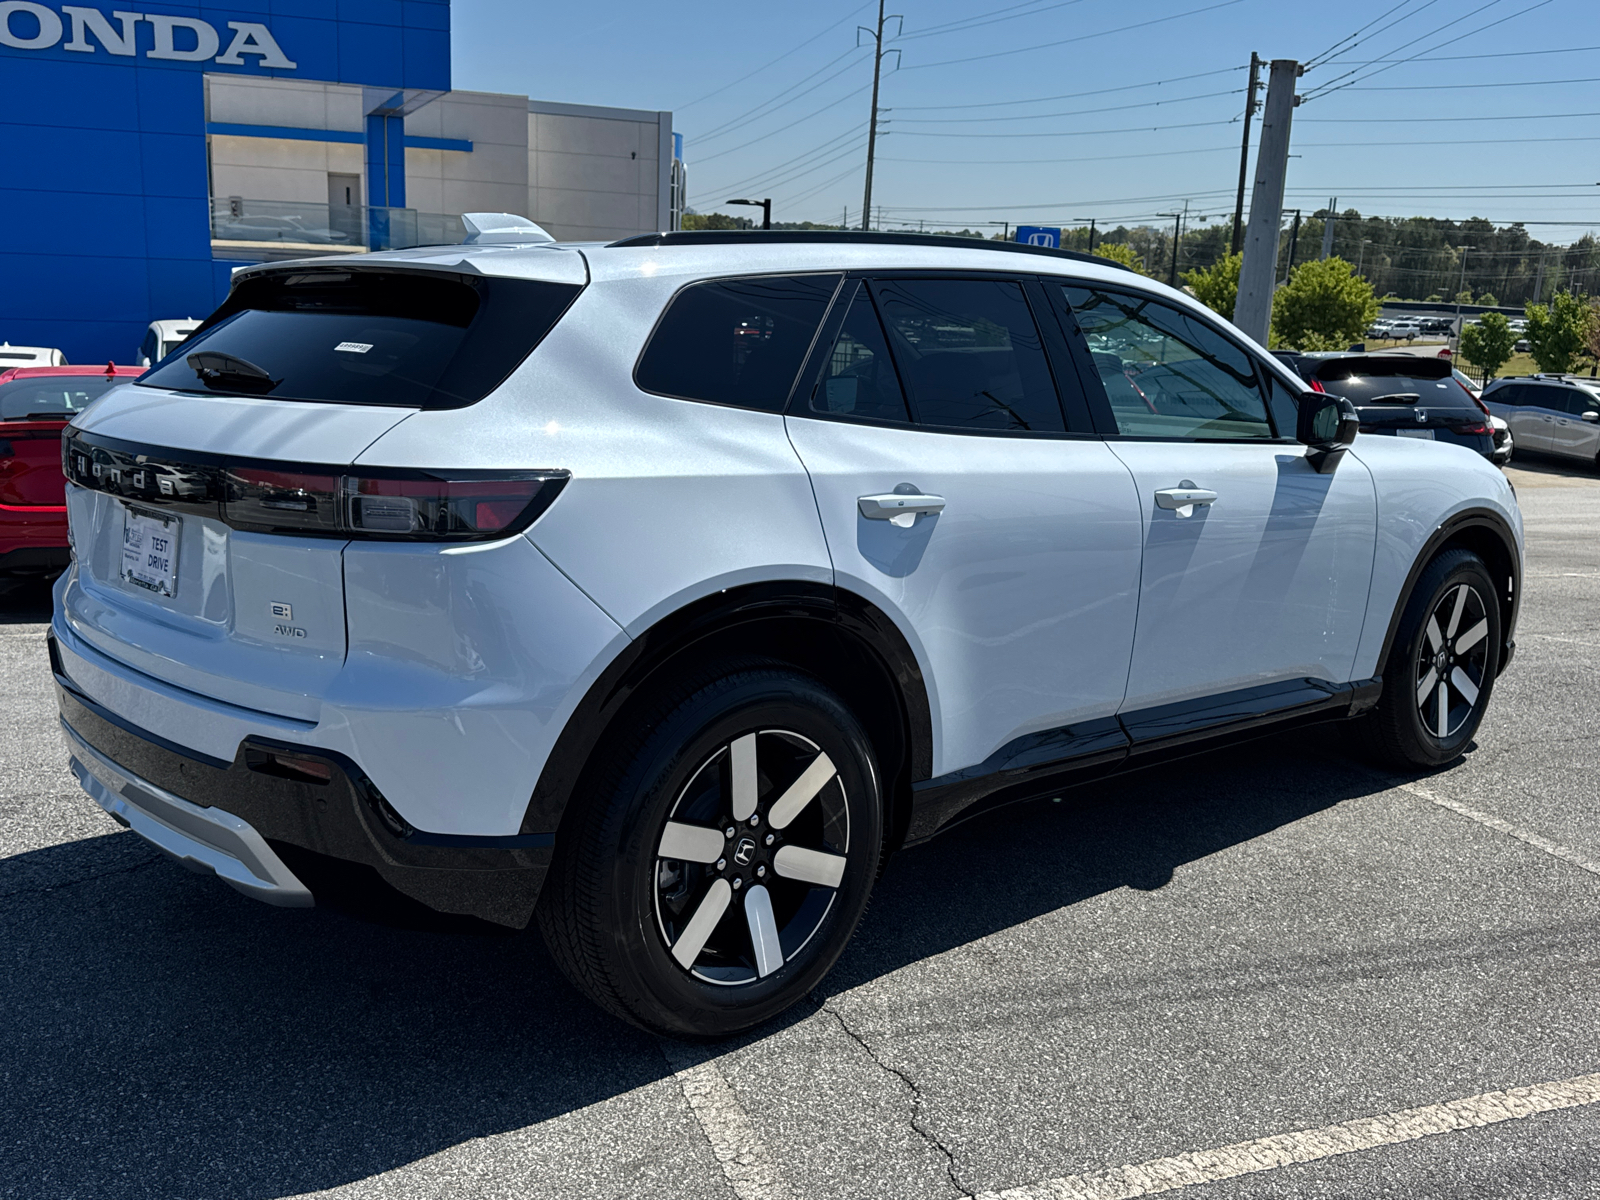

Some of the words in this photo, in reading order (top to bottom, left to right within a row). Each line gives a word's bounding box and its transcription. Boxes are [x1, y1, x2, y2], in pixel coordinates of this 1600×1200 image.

[77, 455, 174, 495] Honda
[151, 536, 168, 553] TEST
[148, 553, 168, 572] DRIVE
[274, 624, 307, 639] AWD
